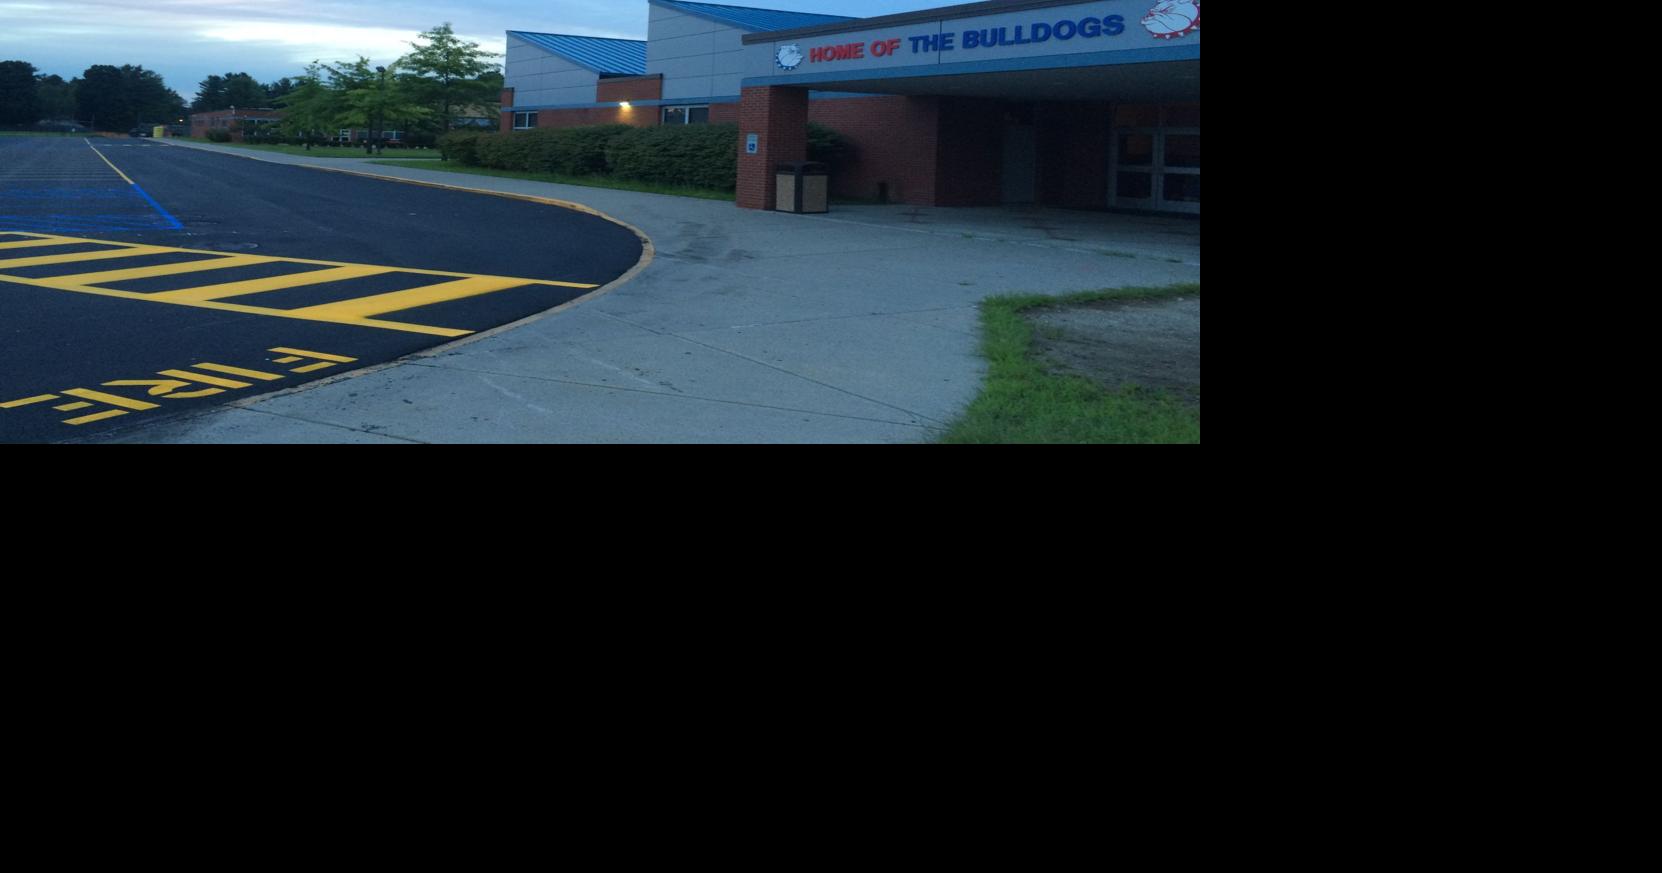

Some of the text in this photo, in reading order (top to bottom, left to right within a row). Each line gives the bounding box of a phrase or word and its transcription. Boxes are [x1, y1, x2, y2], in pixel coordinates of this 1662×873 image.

[809, 14, 1125, 63] HOME OF THE BULLDOGS
[0, 346, 358, 425] FIRE
